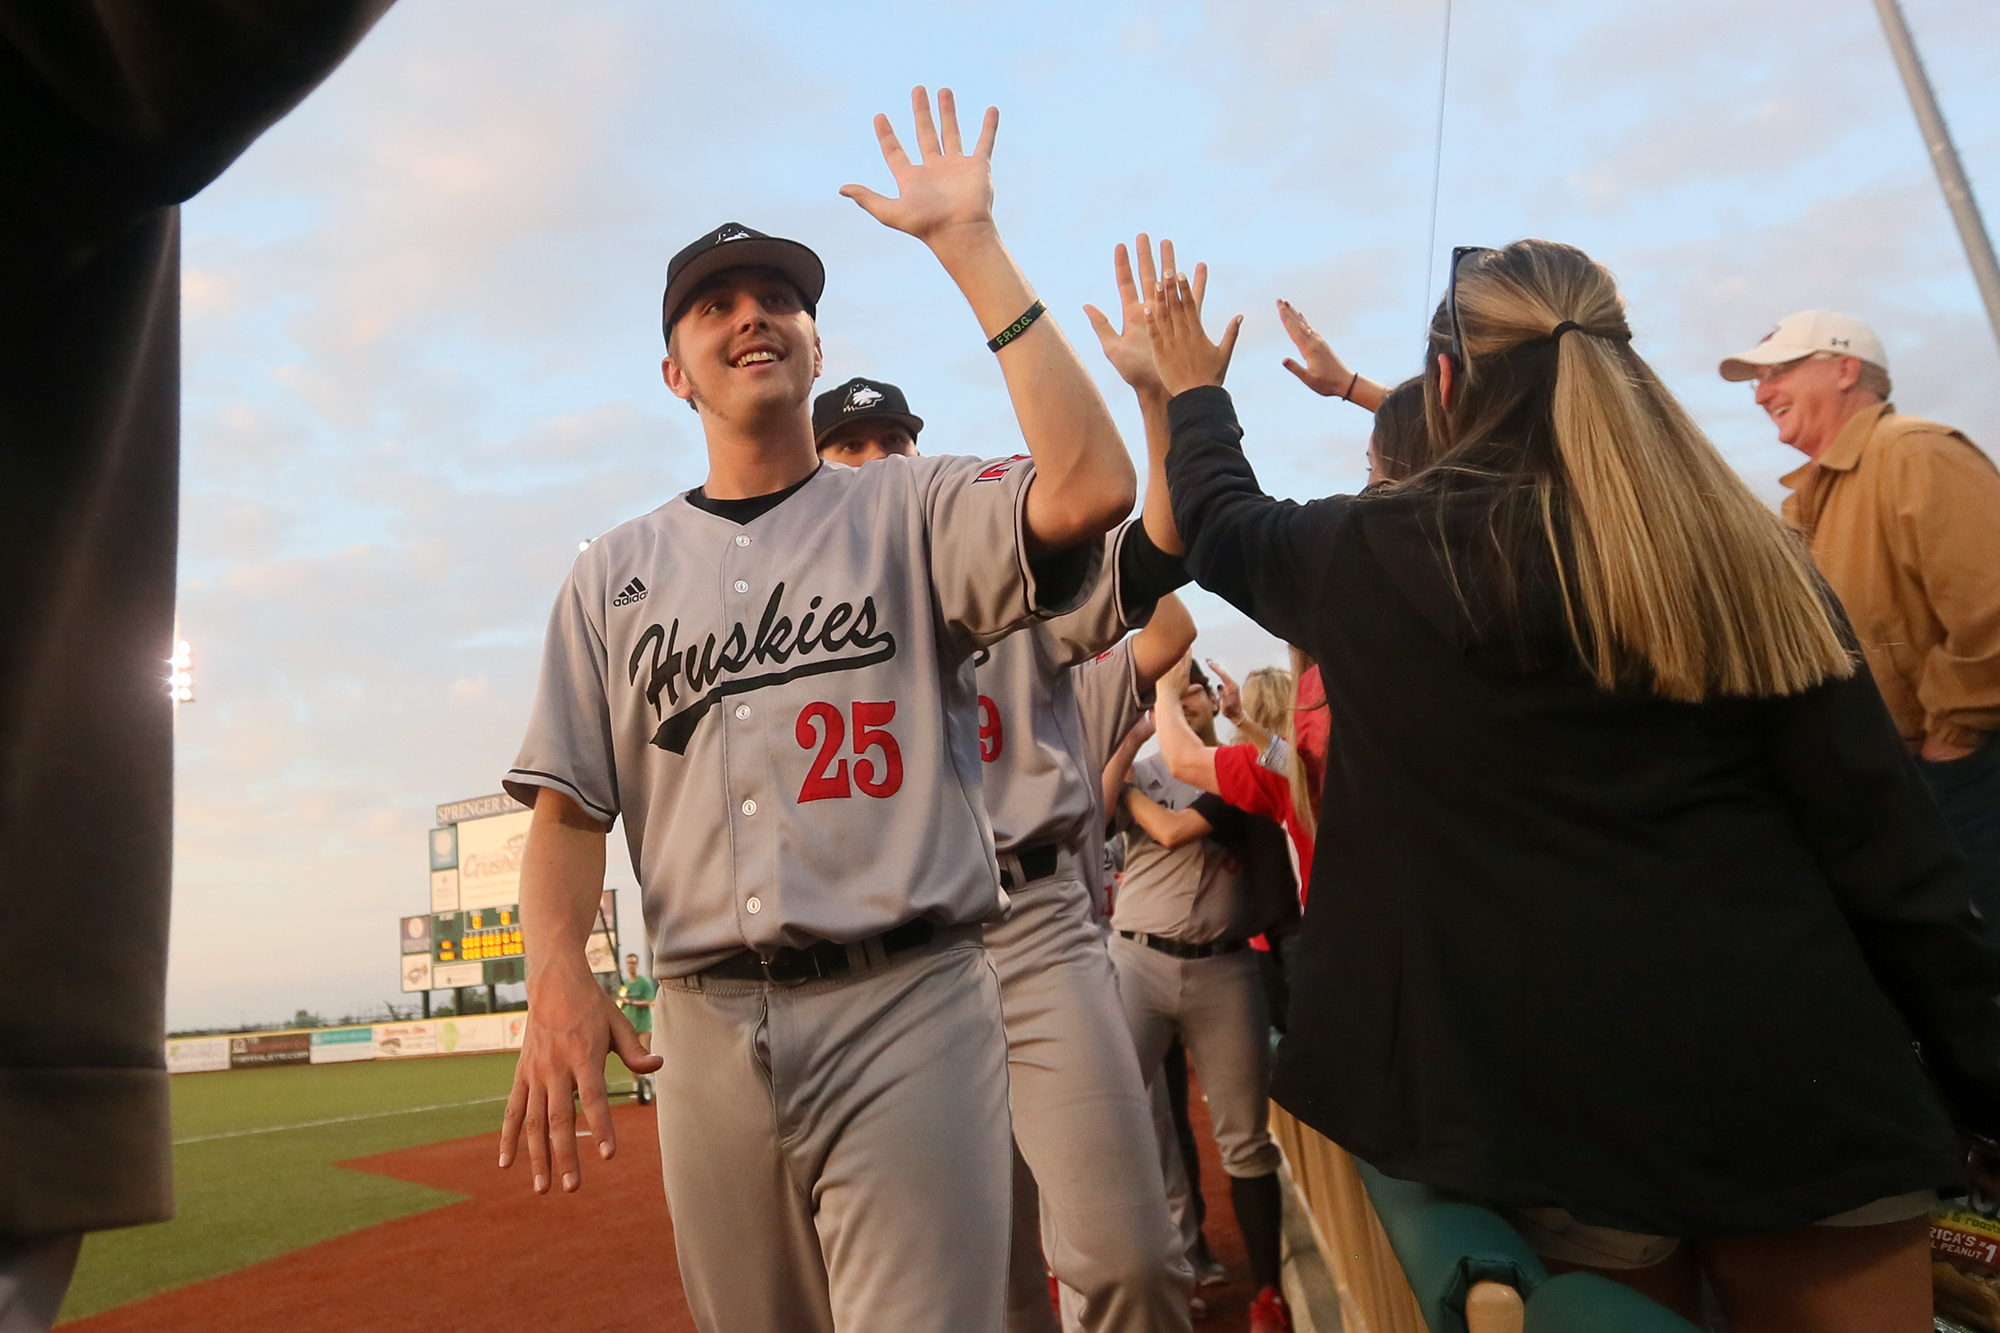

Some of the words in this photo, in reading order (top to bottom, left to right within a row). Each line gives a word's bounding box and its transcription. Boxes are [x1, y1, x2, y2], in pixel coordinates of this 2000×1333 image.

[996, 316, 1032, 346] F.R.O.G.
[613, 589, 649, 607] adida
[628, 581, 896, 722] Huskies
[795, 700, 904, 804] 25
[438, 797, 500, 822] SPRENGER
[1940, 1243, 1983, 1259] PEANUT
[1979, 1241, 1998, 1263] #1
